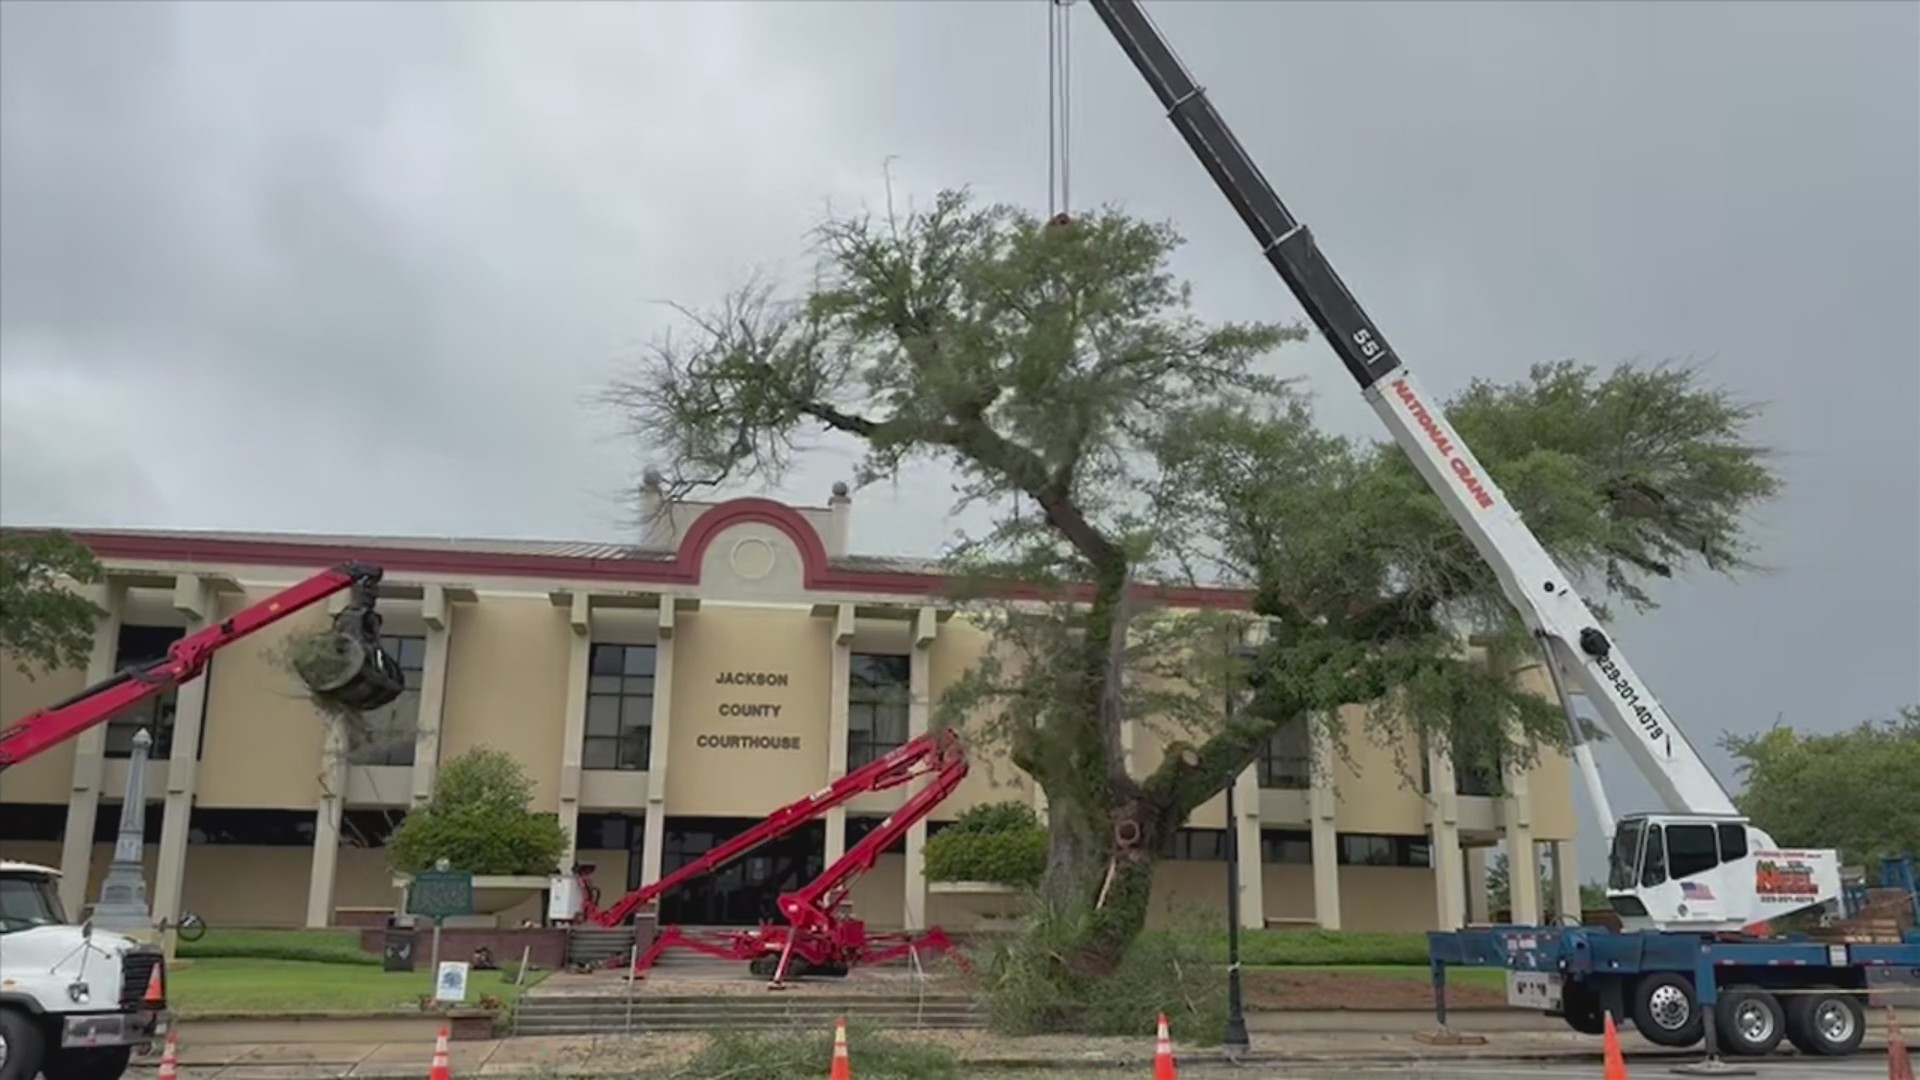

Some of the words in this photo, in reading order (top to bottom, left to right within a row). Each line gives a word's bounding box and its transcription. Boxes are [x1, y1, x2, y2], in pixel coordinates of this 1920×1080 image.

[1391, 379, 1454, 458] NATIONAL
[1450, 457, 1495, 511] CRANE
[716, 672, 788, 686] JACKSON
[1595, 654, 1665, 741] 229-201-4079
[719, 703, 781, 717] COUNTY
[697, 734, 801, 749] COURTHOUSE
